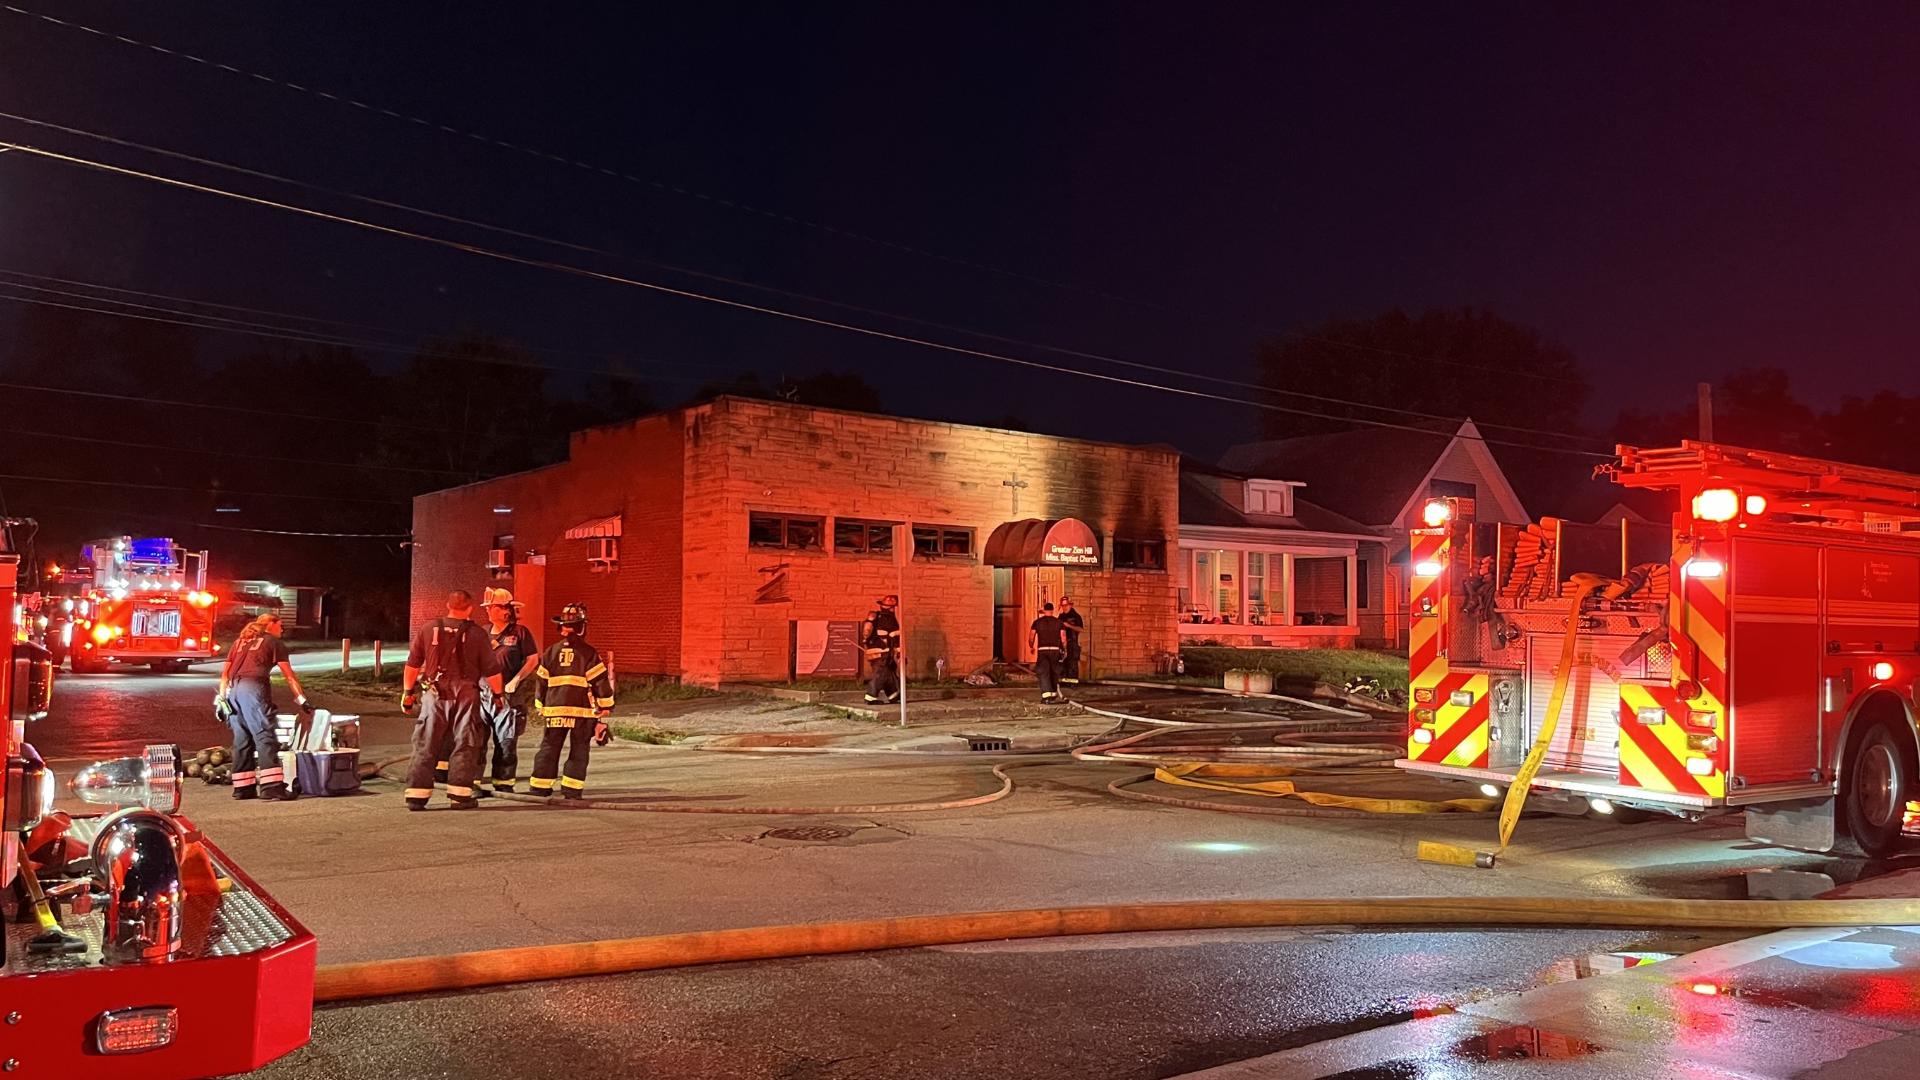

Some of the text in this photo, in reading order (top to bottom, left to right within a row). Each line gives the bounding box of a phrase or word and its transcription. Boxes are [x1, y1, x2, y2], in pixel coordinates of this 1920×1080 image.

[1051, 545, 1093, 555] Greater Zion Hill
[1060, 554, 1079, 564] Baptist
[1079, 555, 1098, 564] Church
